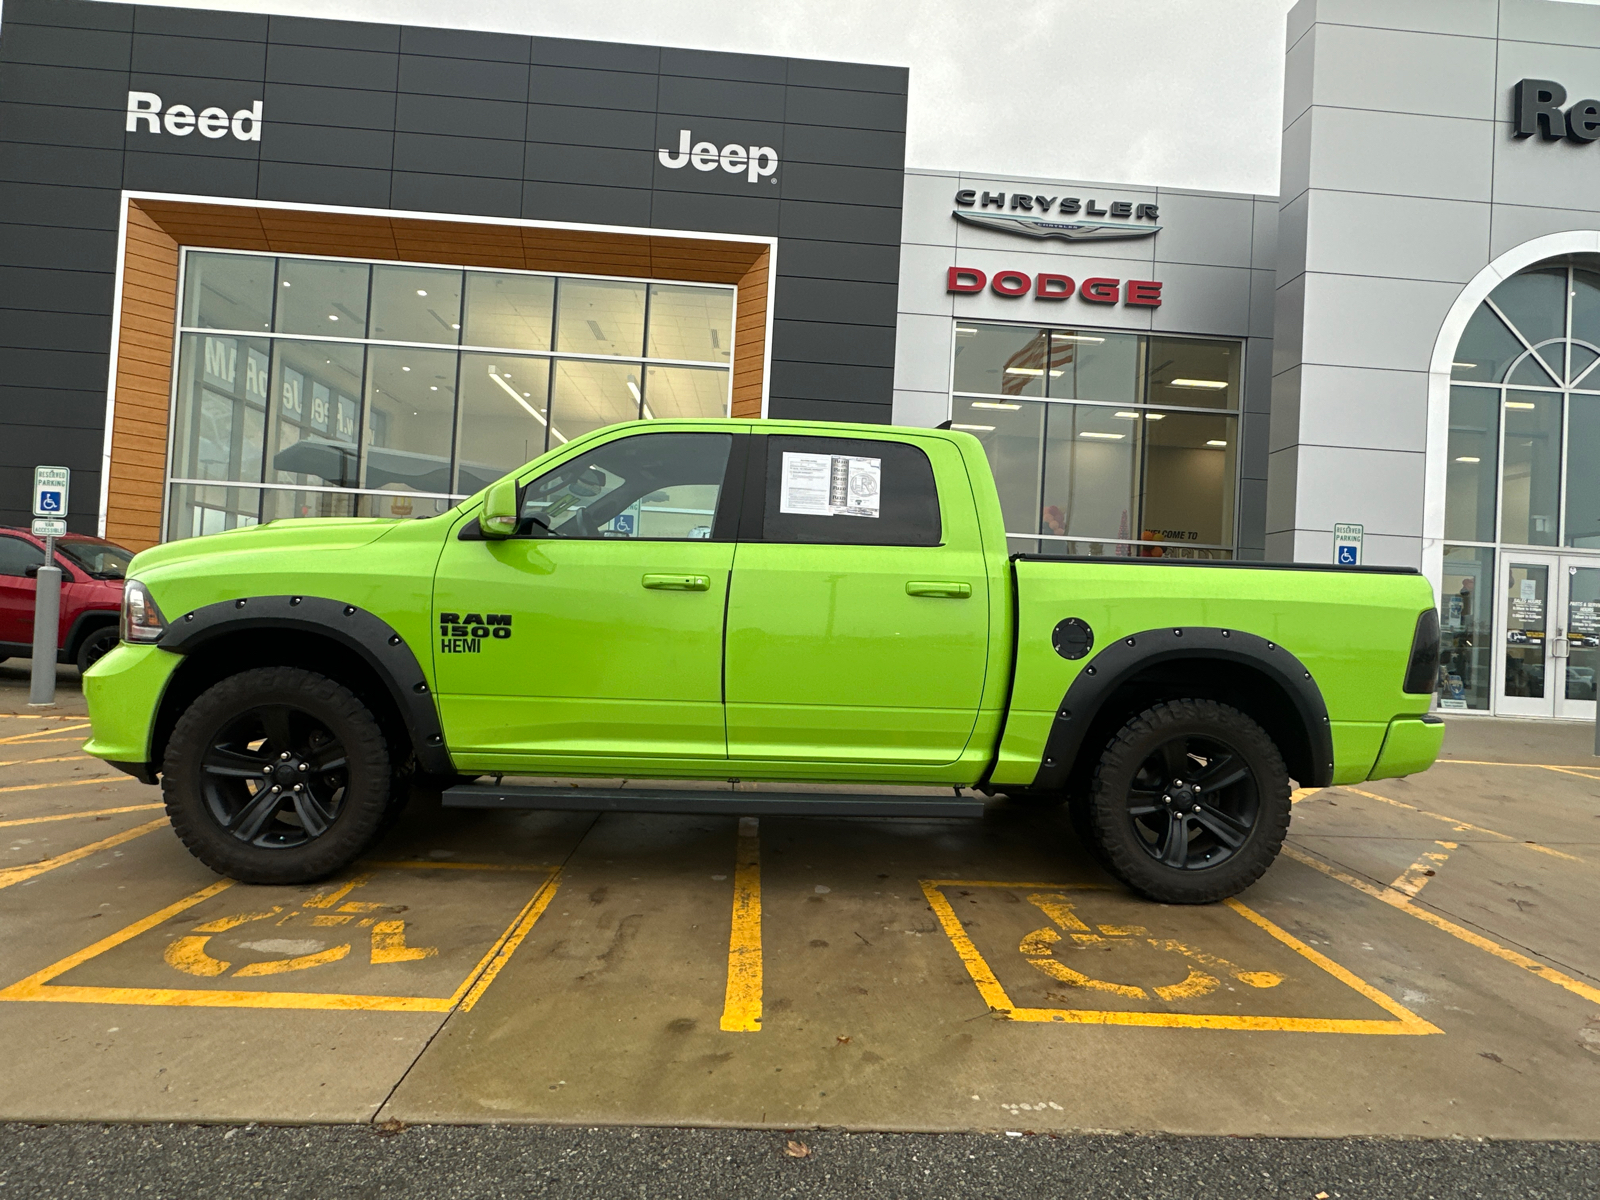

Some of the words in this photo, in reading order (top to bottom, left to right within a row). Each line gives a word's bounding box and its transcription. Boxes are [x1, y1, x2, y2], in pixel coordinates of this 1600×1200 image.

[126, 91, 263, 141] Reed
[658, 129, 778, 183] Jeep
[955, 189, 1160, 219] CHRYSLER
[947, 266, 1163, 309] DODGE
[39, 471, 66, 479] RESERVED
[1188, 531, 1198, 540] TO
[1336, 526, 1361, 535] RESERVED
[1336, 535, 1361, 543] PARKING
[440, 612, 512, 626] RAM
[440, 625, 512, 639] 1500
[441, 638, 481, 653] HEMI
